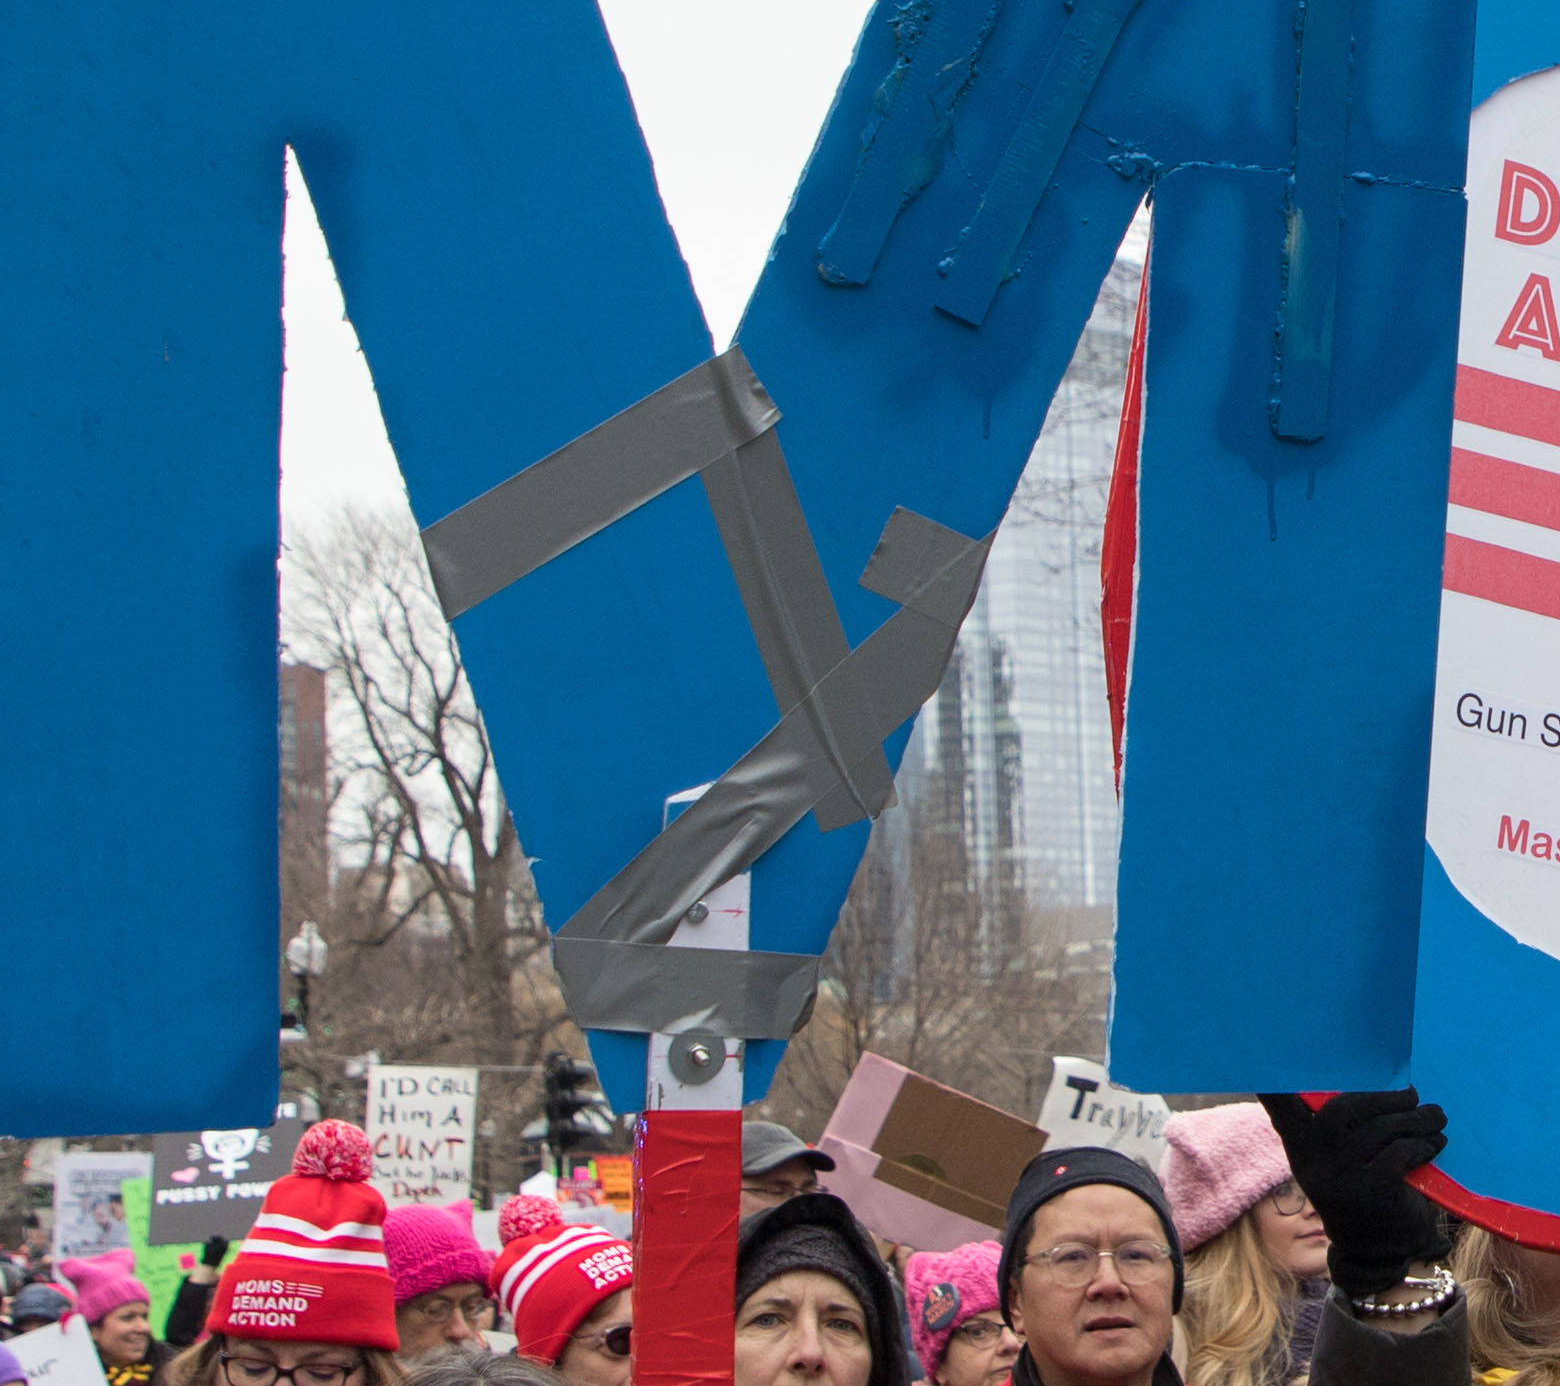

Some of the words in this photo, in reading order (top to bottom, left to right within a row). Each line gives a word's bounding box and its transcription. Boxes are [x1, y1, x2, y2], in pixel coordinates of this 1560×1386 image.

[1455, 692, 1528, 743] Gun
[440, 1106, 461, 1126] A
[375, 1134, 464, 1161] CUNT
[156, 1185, 222, 1205] PUSSY
[226, 1181, 273, 1198] POW
[586, 1256, 633, 1279] DEMA
[235, 1280, 283, 1294] MOMS
[232, 1296, 307, 1312] DEMAND
[228, 1312, 296, 1326] ACTION
